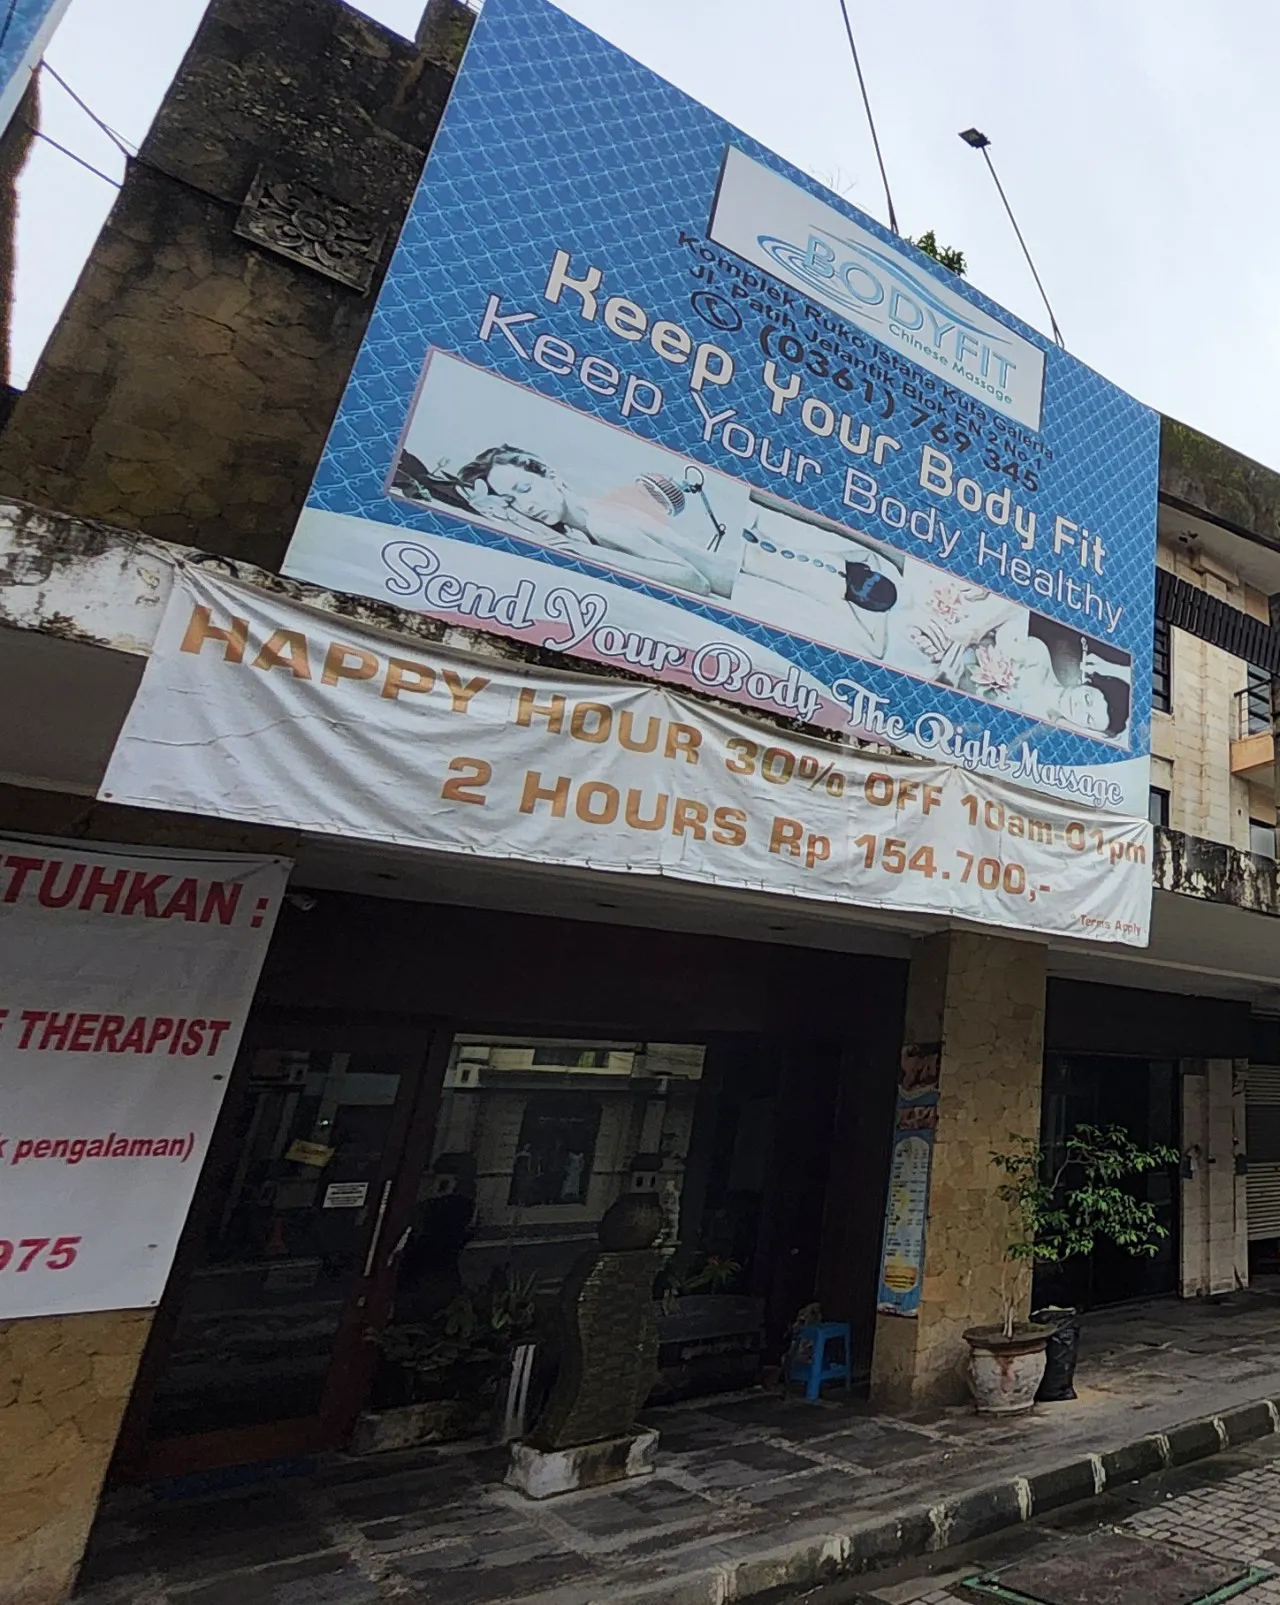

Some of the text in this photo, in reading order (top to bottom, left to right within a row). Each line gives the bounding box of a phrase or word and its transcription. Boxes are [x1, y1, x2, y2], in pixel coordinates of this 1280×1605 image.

[678, 231, 1054, 461] Komplek Ruko Istana Kuta Galeria
[731, 283, 796, 332] Patih
[803, 330, 896, 388] Jelantik
[901, 381, 948, 419] Blok
[954, 411, 983, 438] EN
[986, 430, 999, 446] 2
[803, 233, 1017, 389] BODYFIT
[888, 323, 1013, 405] Chinese Massage
[477, 294, 1124, 635] Keep Your Body Healthy
[543, 247, 1107, 578] Keep Your Body Fit
[759, 323, 1039, 493] (0361) 769 345
[179, 602, 493, 714] HAPPY
[513, 686, 704, 766] HOUR
[725, 735, 847, 798] 30%
[864, 771, 944, 816] OFF
[380, 540, 1126, 809] Send Your Body The Right Massage
[0, 855, 243, 925] TUHKAN
[439, 756, 494, 807] 2
[518, 770, 749, 848] HOURS
[767, 815, 833, 870] Rp
[1080, 914, 1142, 937] Terms Apply
[17, 1010, 232, 1057] THERAPIST
[10, 1131, 196, 1166] pengalaman)
